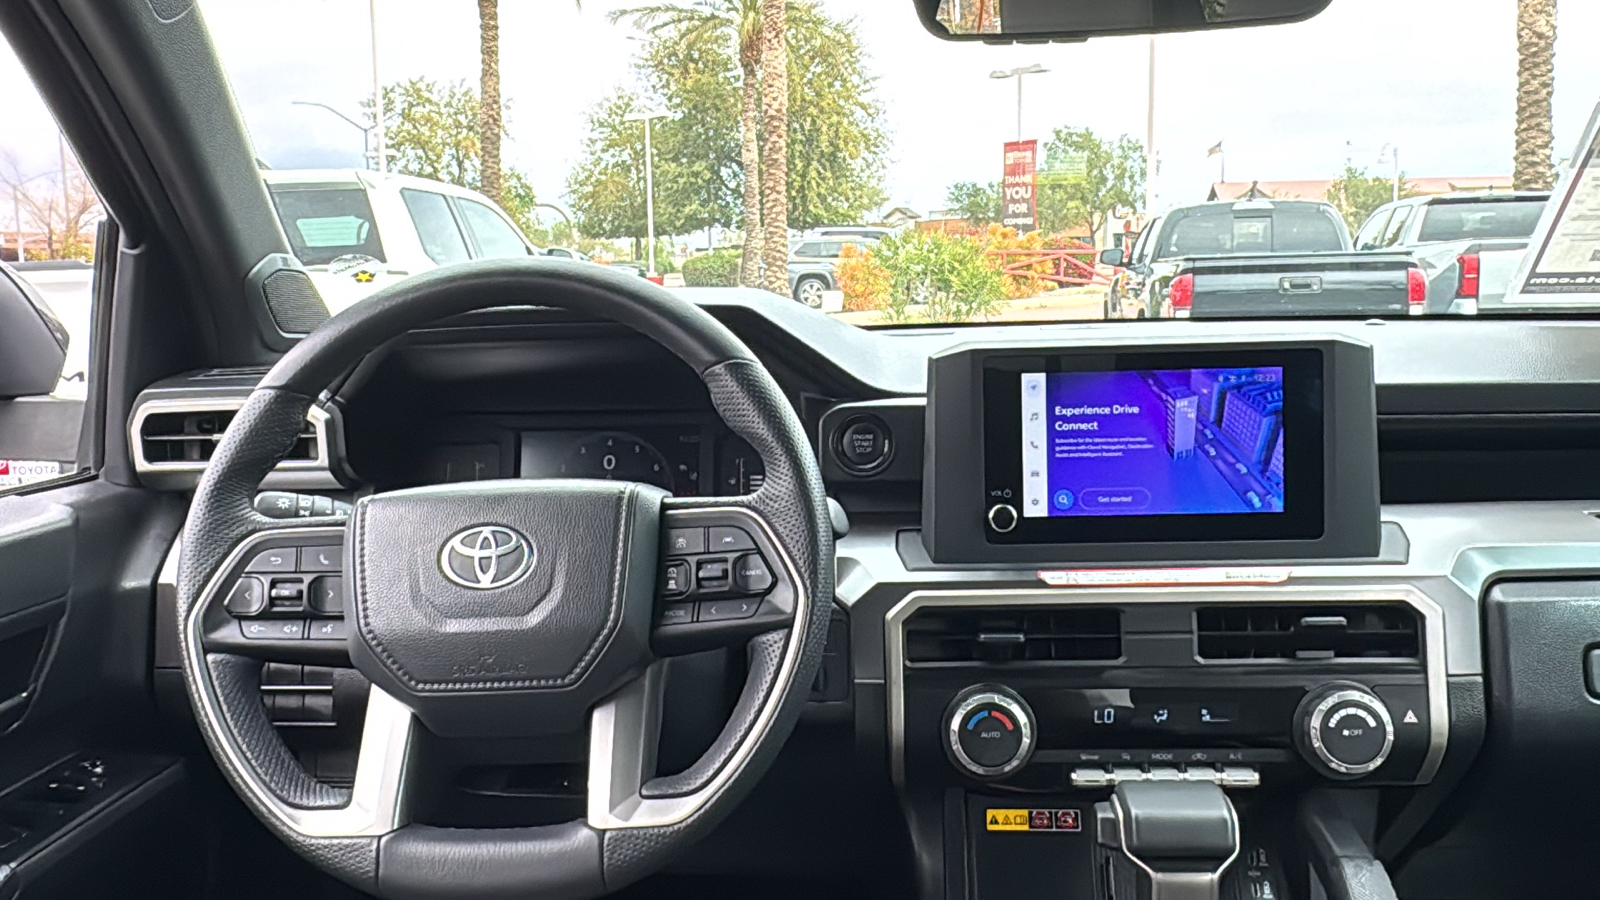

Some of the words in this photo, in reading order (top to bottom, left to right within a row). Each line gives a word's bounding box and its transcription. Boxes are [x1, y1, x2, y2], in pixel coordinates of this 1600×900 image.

[1005, 174, 1033, 184] THANK
[1005, 186, 1032, 200] YOU
[1009, 203, 1028, 214] FOR
[1054, 405, 1111, 416] Experience
[1112, 404, 1140, 414] Drive
[1054, 420, 1099, 431] Connect
[602, 454, 616, 470] 0
[12, 466, 57, 475] TOYOTA
